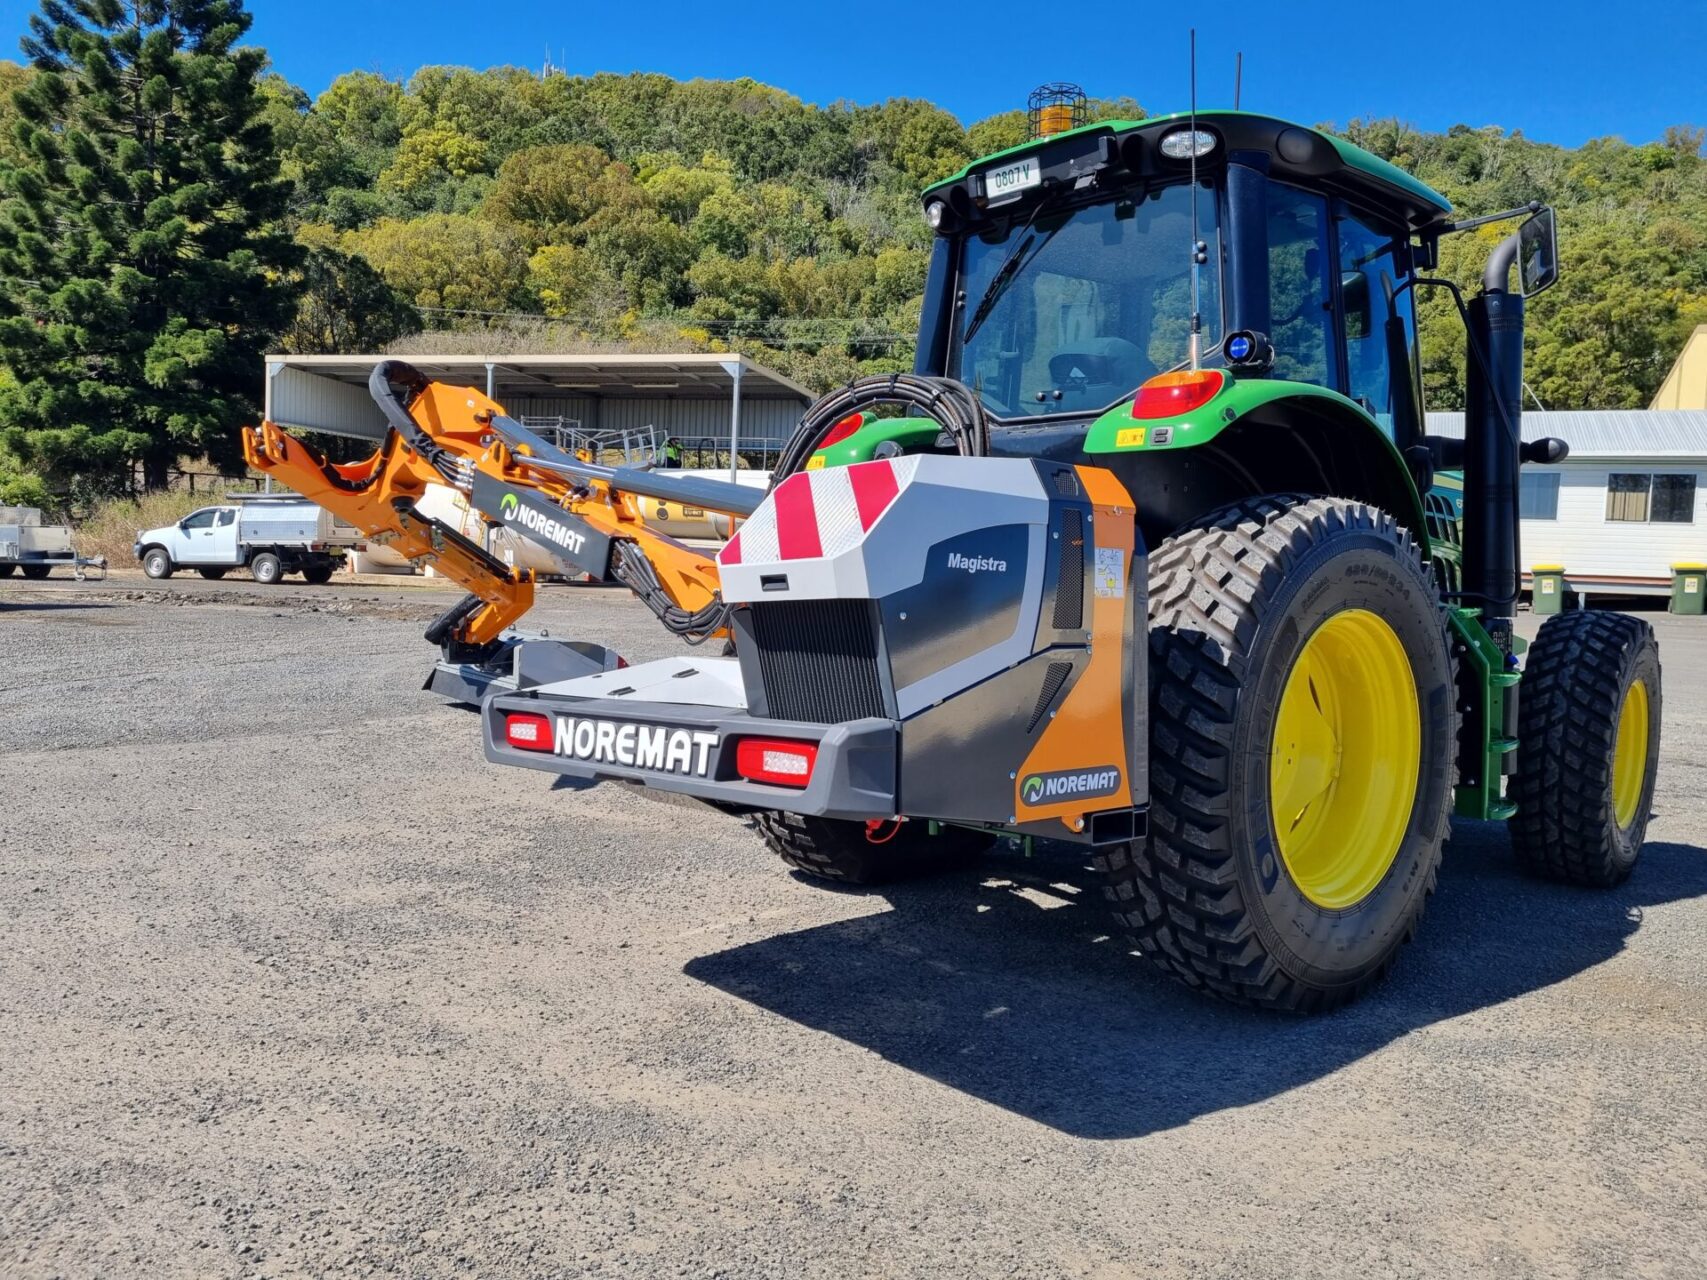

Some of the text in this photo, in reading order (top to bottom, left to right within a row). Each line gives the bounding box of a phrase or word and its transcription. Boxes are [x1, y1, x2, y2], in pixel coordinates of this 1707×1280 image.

[995, 163, 1030, 188] 0807 V
[517, 503, 585, 554] NOREMAT
[947, 552, 1007, 573] Magistra
[553, 716, 719, 776] NOREMAT
[1045, 771, 1118, 796] NOREMAT
